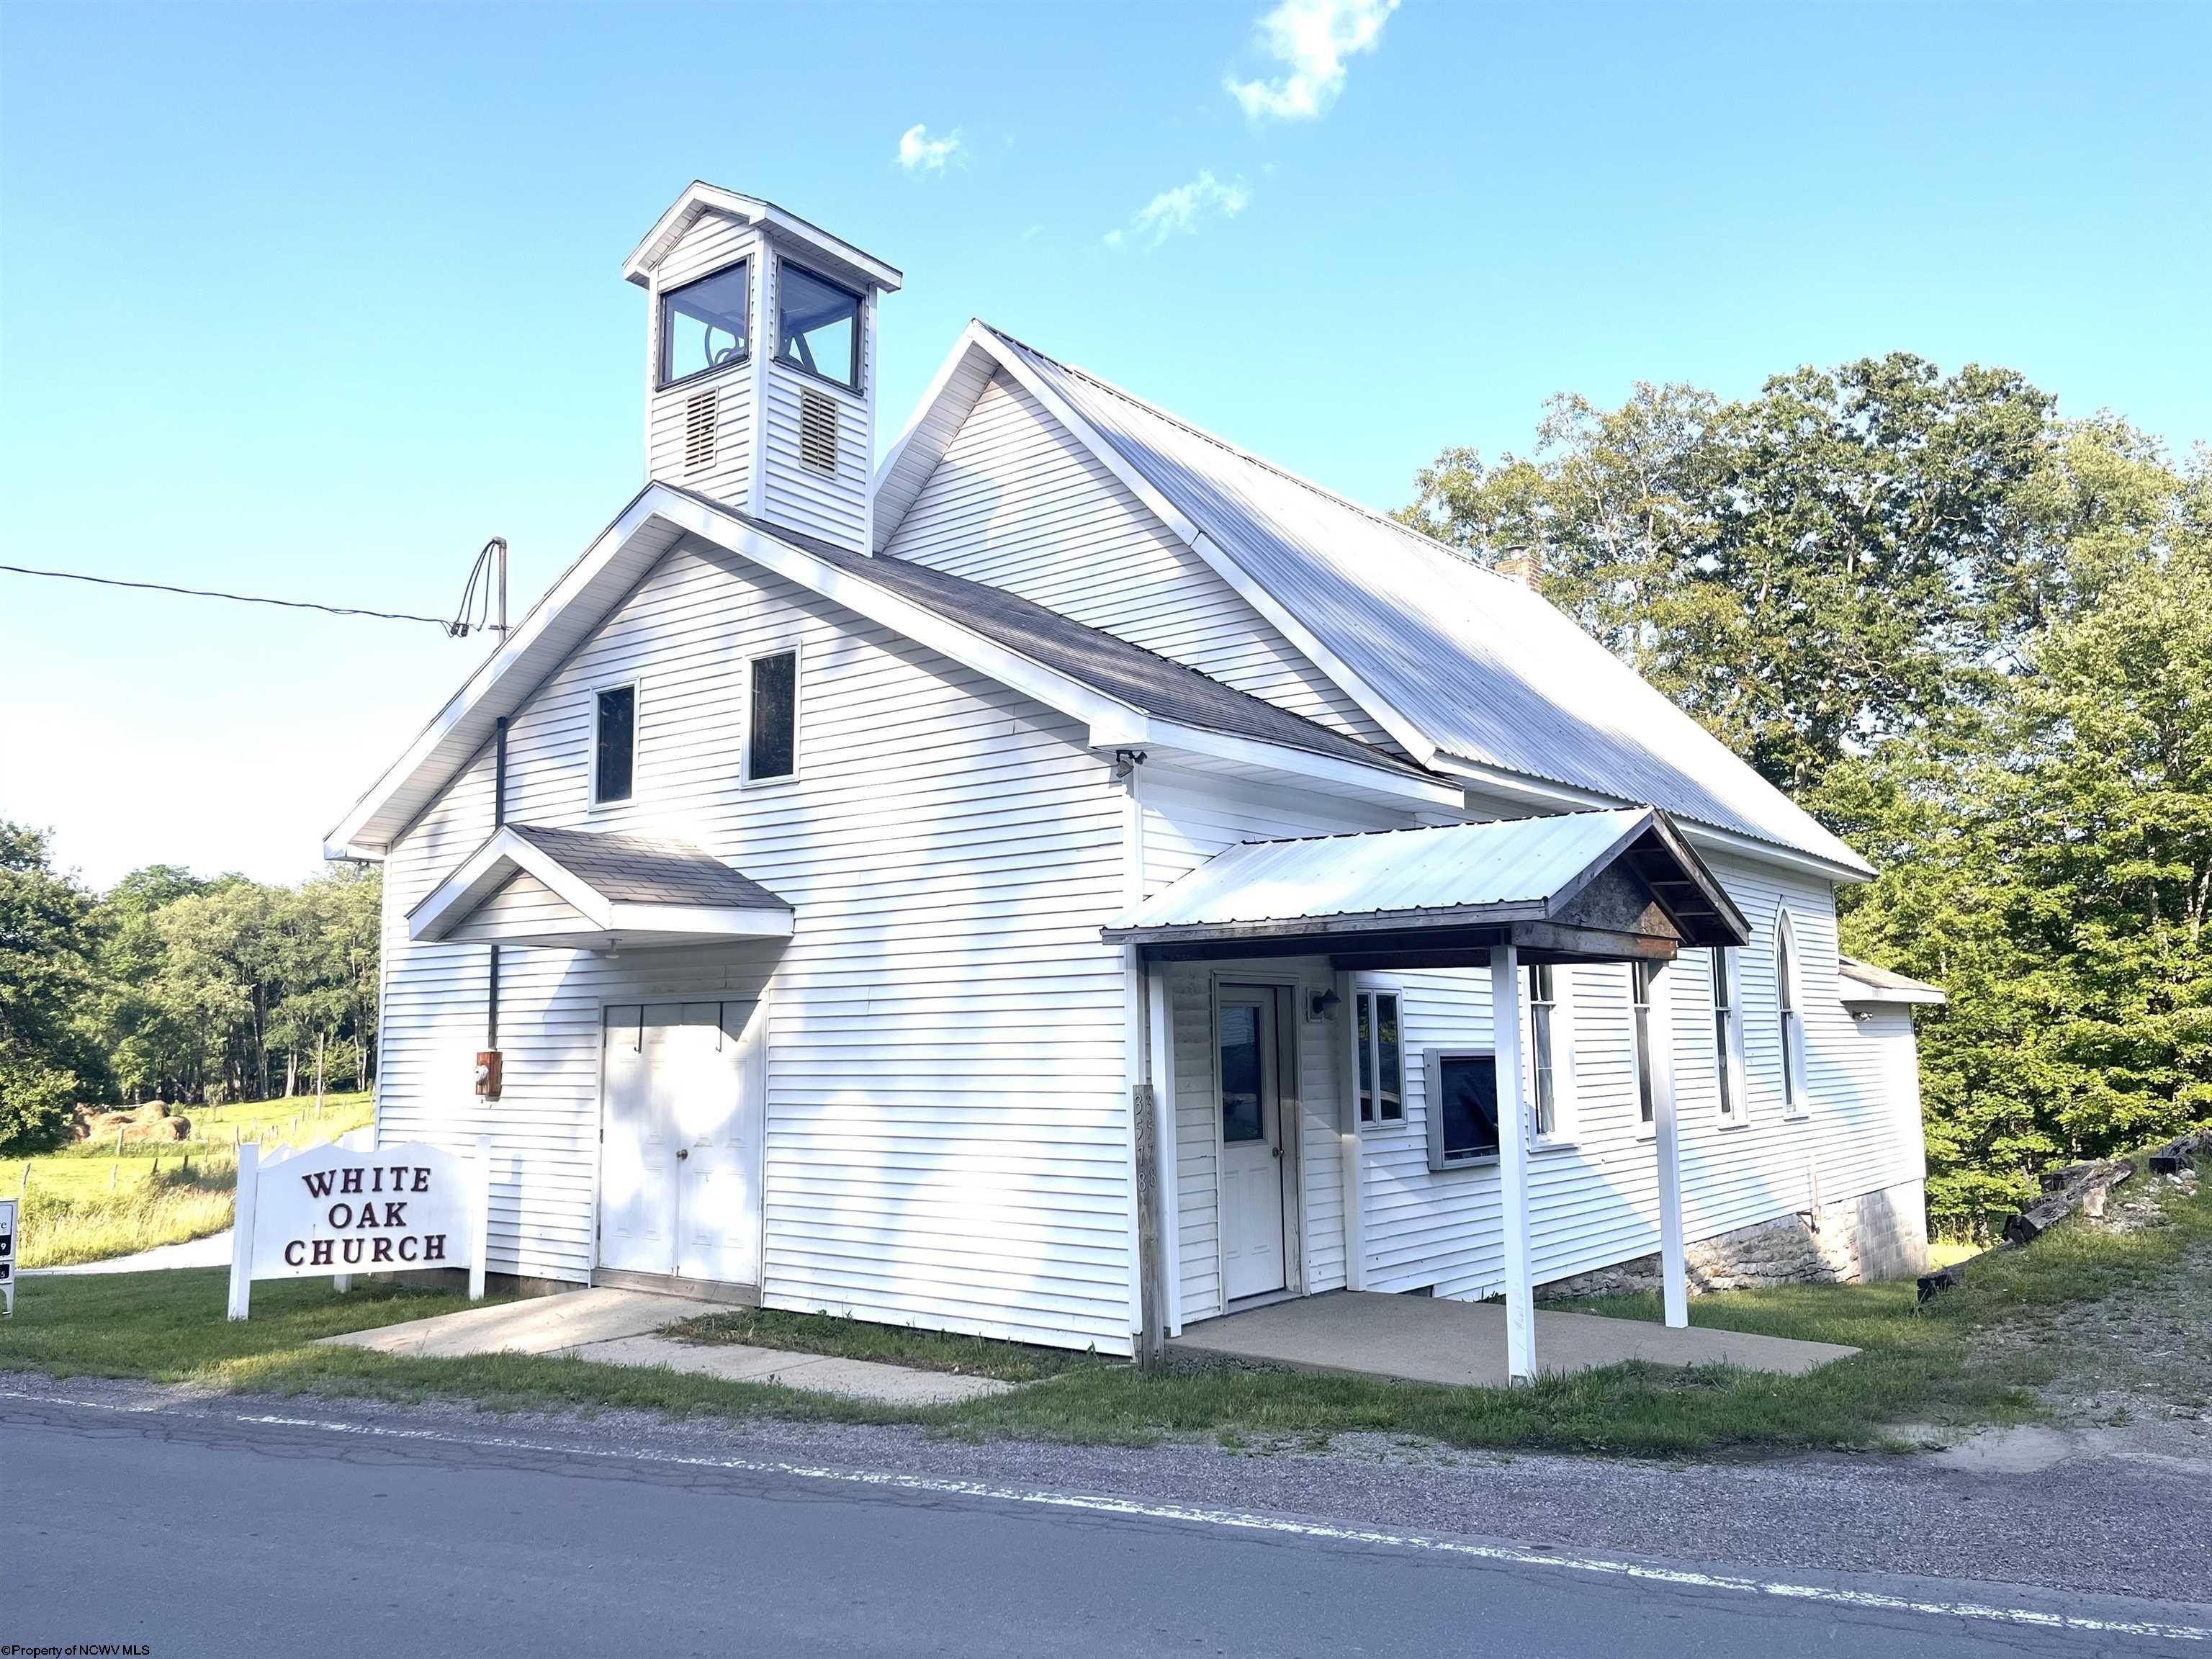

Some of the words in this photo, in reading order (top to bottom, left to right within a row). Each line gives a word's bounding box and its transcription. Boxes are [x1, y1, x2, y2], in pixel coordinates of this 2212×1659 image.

[302, 1166, 431, 1198] WHITE
[328, 1202, 407, 1228] OAK
[284, 1234, 446, 1266] CHURCH
